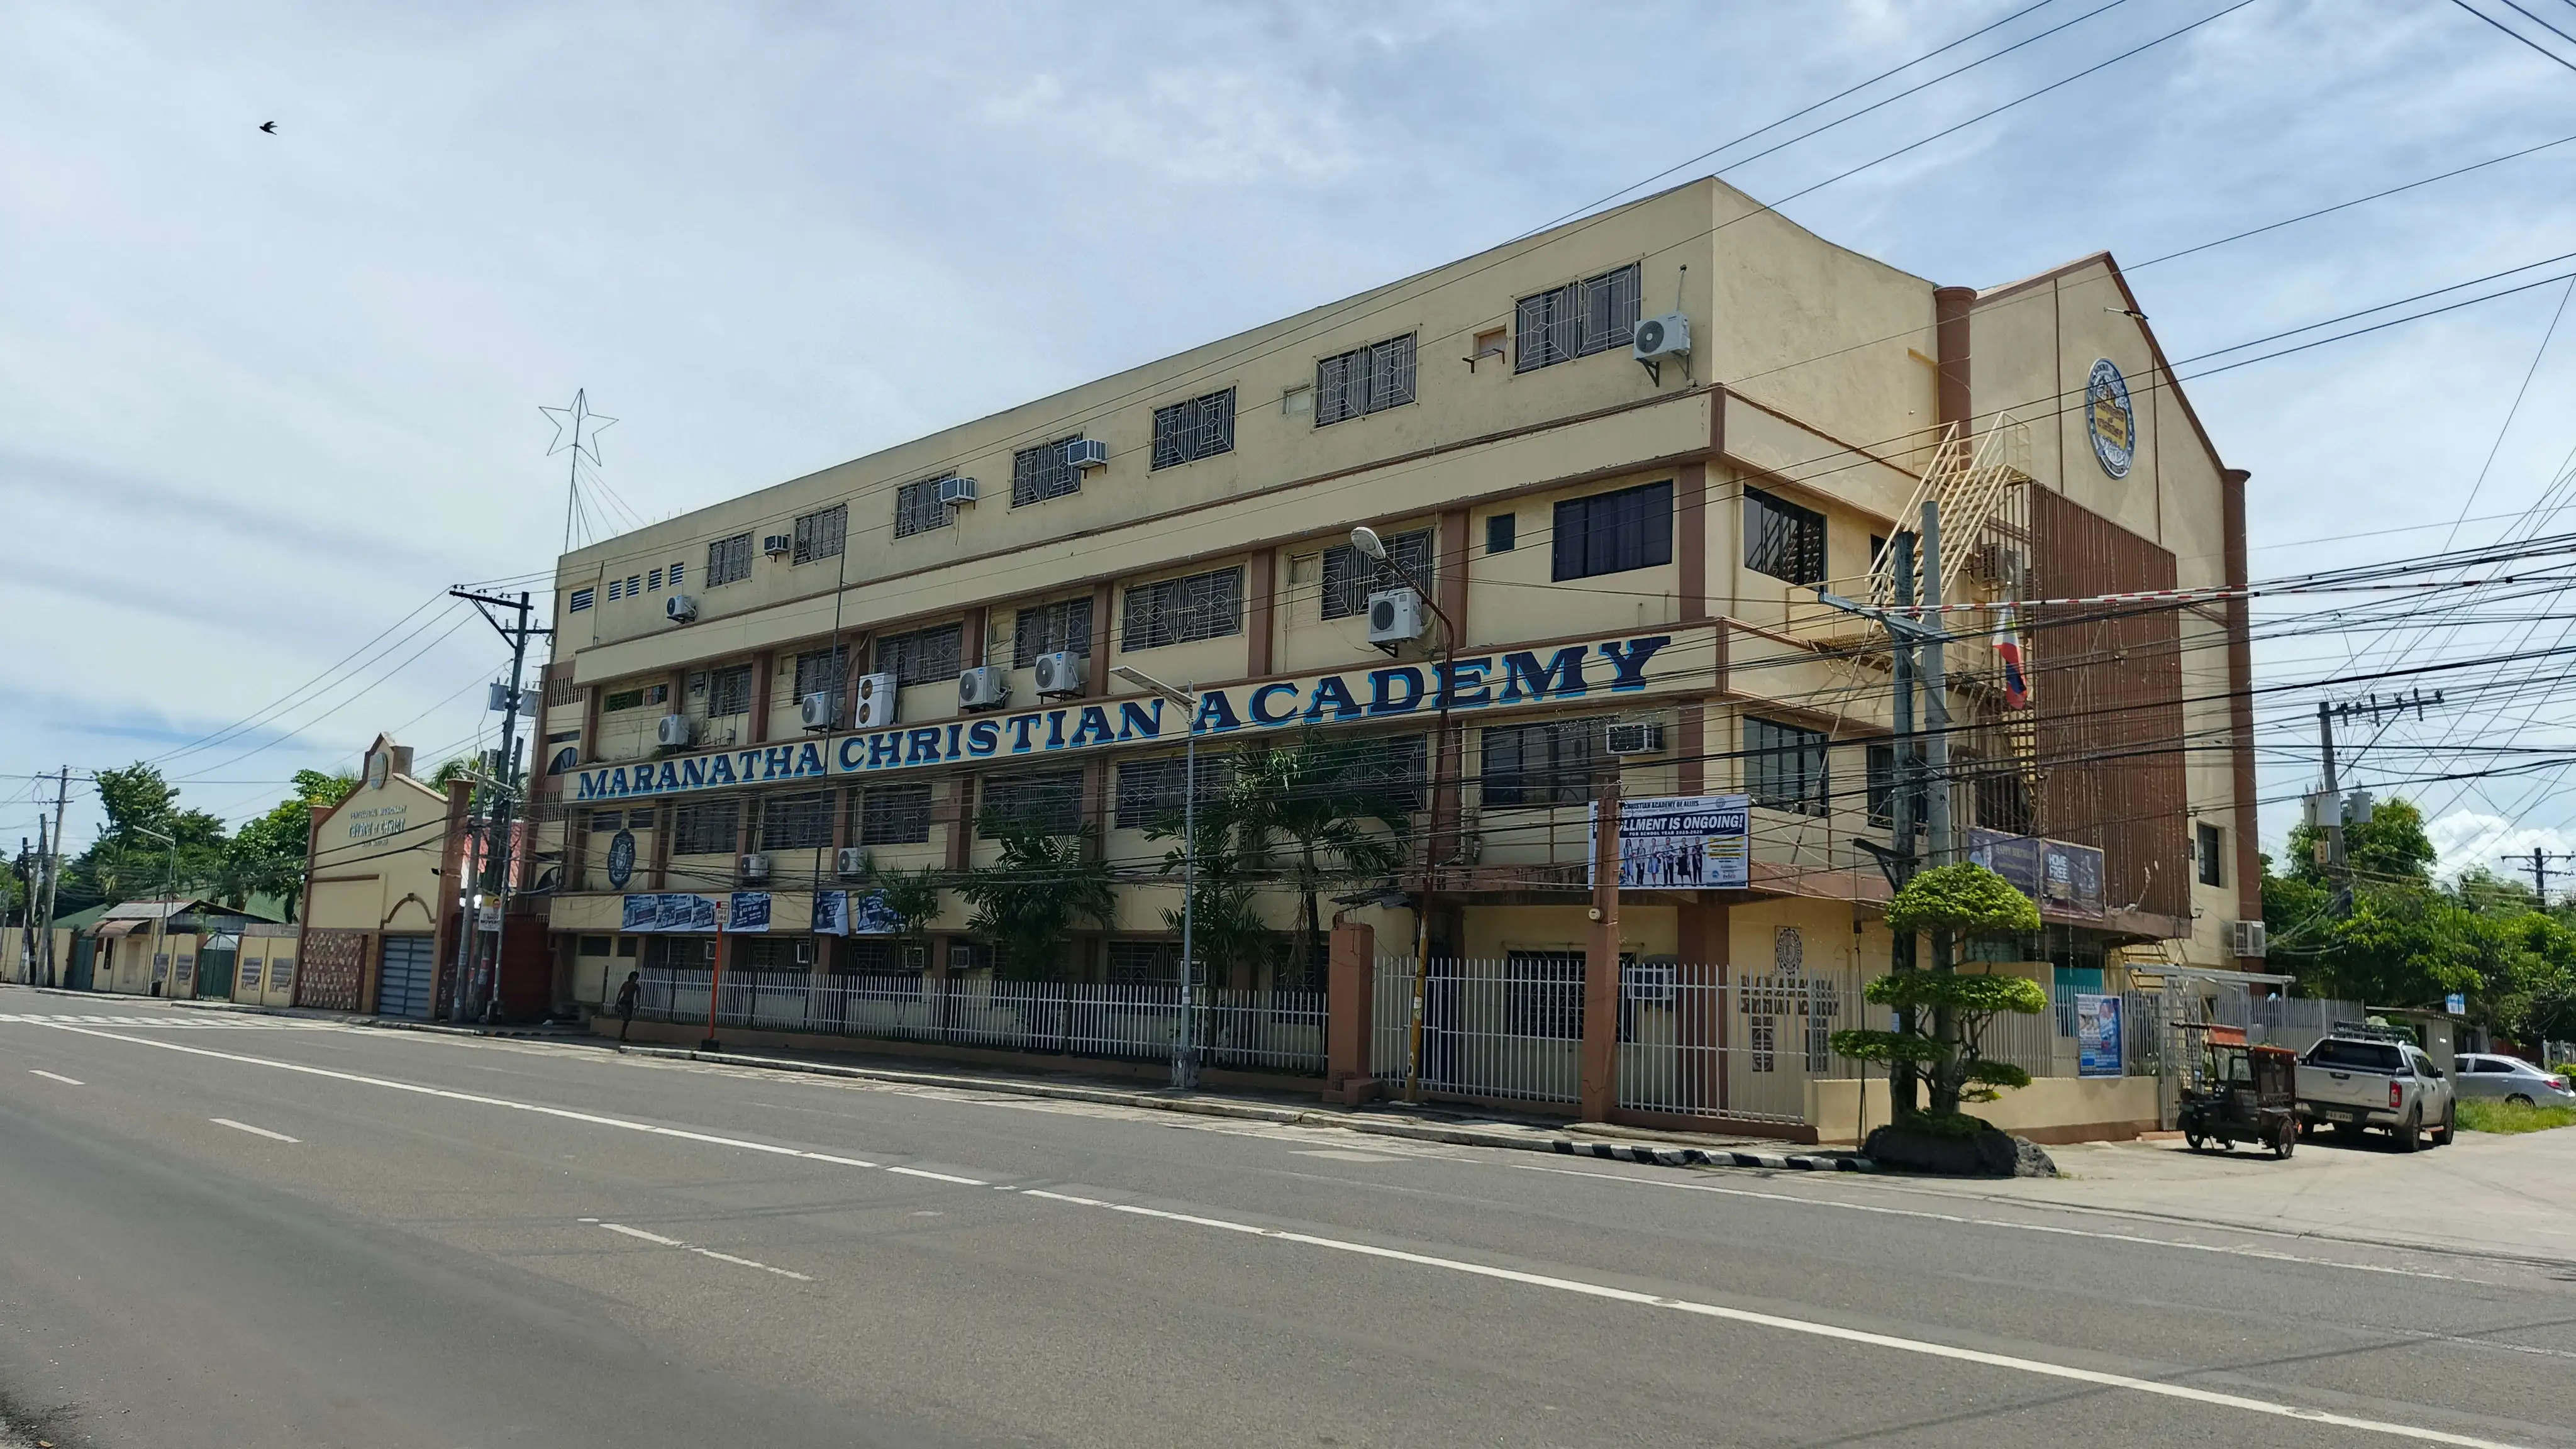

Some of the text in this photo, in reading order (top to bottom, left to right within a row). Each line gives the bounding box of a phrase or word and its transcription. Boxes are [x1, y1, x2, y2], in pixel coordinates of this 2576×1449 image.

[577, 636, 1671, 801] MARANATHA CHRISTIAN ACADEMY
[380, 818, 406, 835] CHRIST
[1668, 817, 1680, 830] IS
[1683, 815, 1743, 829] ONGOING!
[2048, 853, 2067, 867] HOME
[2049, 866, 2068, 879] FREE
